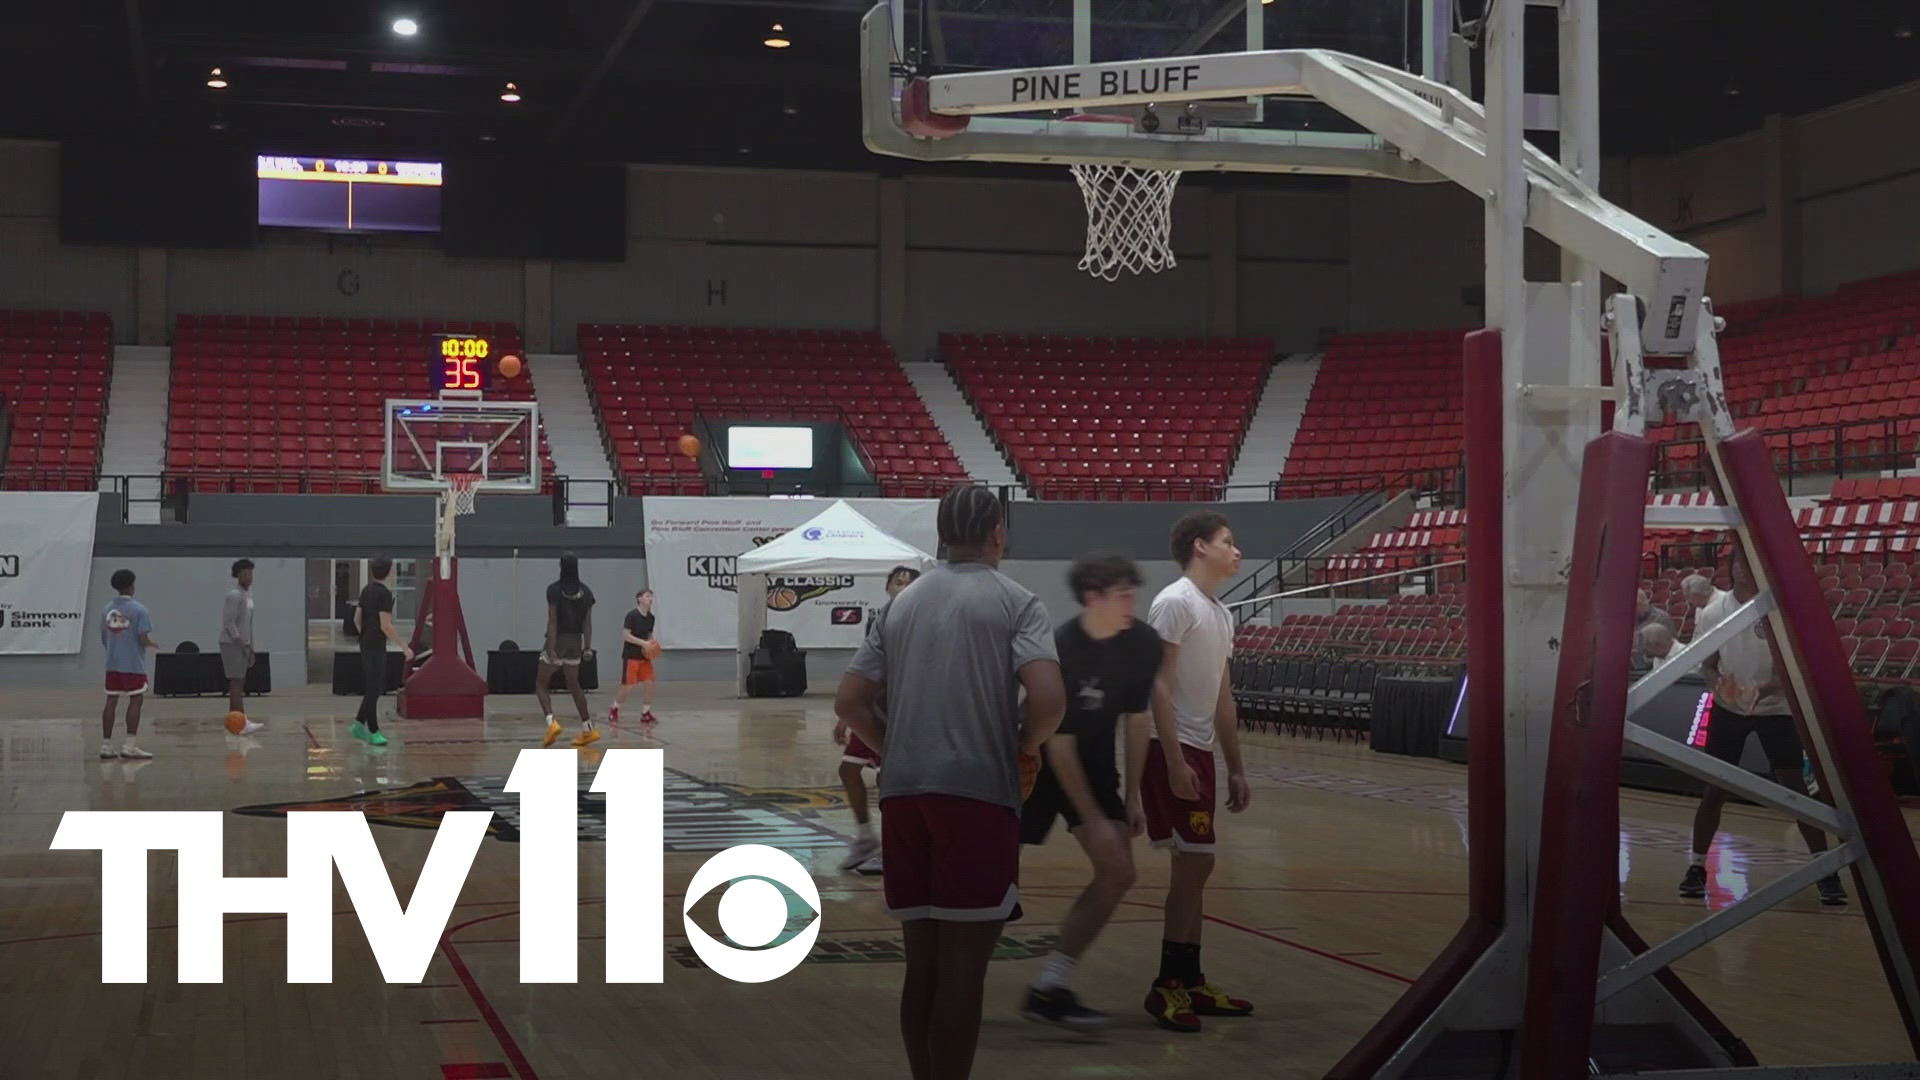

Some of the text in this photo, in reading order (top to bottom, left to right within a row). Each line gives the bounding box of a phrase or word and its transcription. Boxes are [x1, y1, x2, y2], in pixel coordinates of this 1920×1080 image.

[1012, 65, 1200, 101] PINE BLUFF
[706, 279, 728, 306] H
[442, 339, 488, 358] 10:00
[445, 358, 480, 388] 35
[783, 575, 854, 588] CLASSIC
